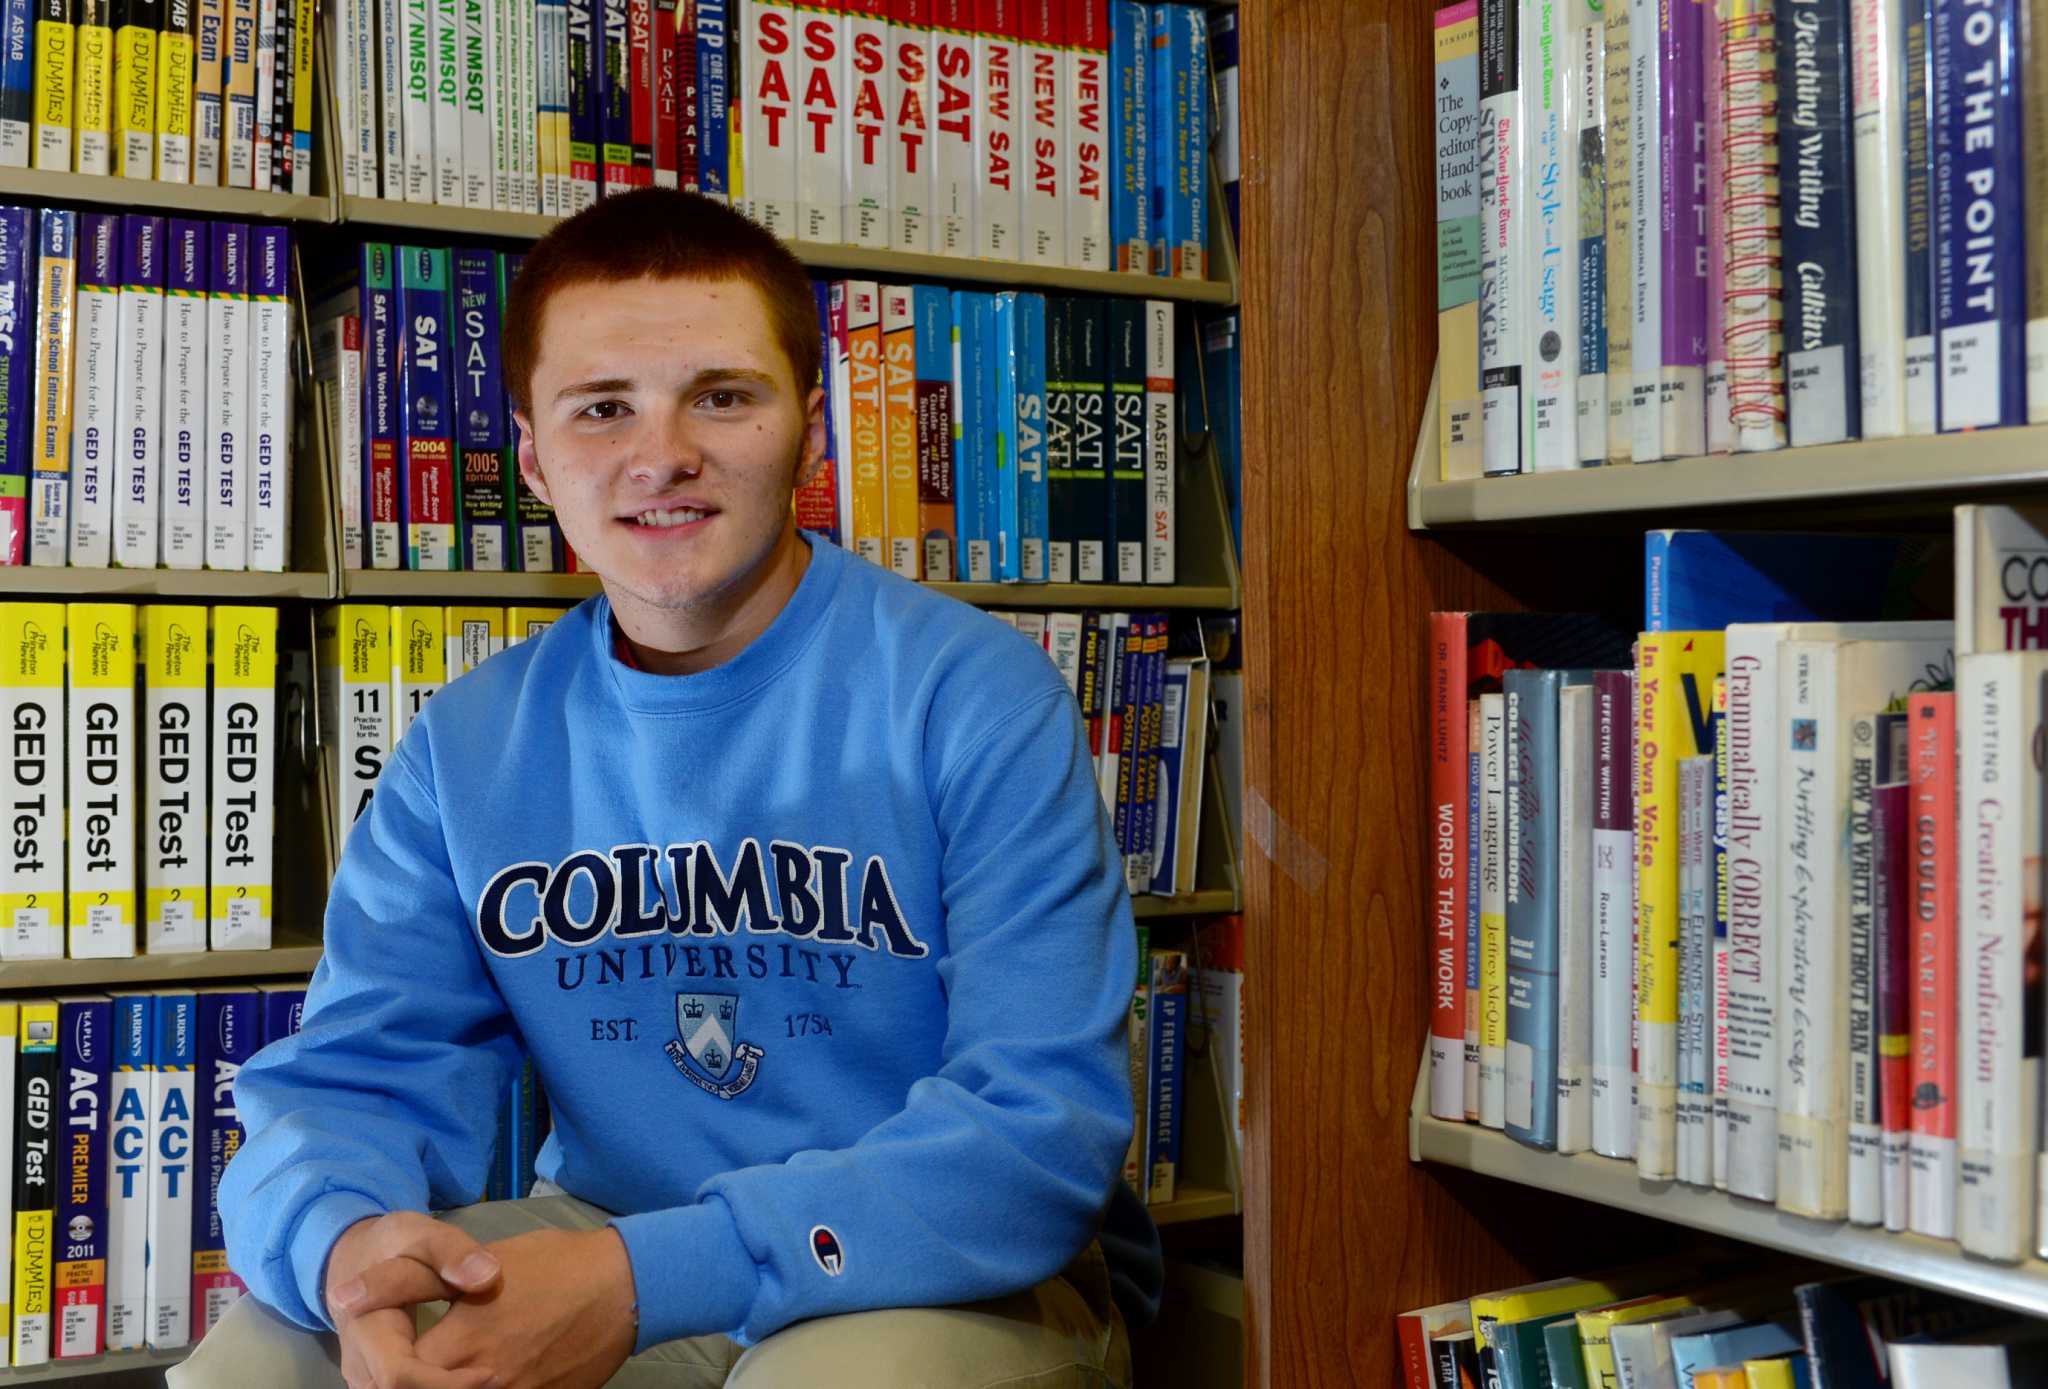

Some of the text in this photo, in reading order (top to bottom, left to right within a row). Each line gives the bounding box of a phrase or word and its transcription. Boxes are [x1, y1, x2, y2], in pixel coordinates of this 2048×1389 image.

[11, 15, 25, 61] ASVAB
[201, 15, 220, 62] Exam
[359, 34, 368, 90] Questions
[1936, 13, 1950, 125] DICTIONARY
[46, 38, 65, 123] DUMMIES
[661, 48, 674, 113] PSAT
[711, 54, 724, 118] CORE EXAMS
[758, 12, 790, 147] SAT
[804, 20, 836, 153] SAT
[938, 44, 971, 142] SAT
[988, 45, 1010, 191] NEW SAT
[1135, 54, 1145, 108] Official
[1439, 95, 1464, 113] The
[1637, 54, 1646, 112] WRITING
[1793, 10, 1824, 228] Teaching Writing
[1964, 59, 1994, 153] THE
[361, 129, 370, 153] New
[686, 87, 697, 155] PSAT
[1077, 59, 1100, 200] NEW SAT
[1136, 112, 1146, 142] SAT
[1440, 116, 1479, 134] Copy-
[1481, 108, 1495, 207] STYLE
[1135, 144, 1146, 191] Study
[1440, 159, 1480, 179] Hand-
[1441, 182, 1472, 202] book
[1497, 119, 1511, 248] The New York Times
[1536, 163, 1562, 222] Style
[1637, 143, 1646, 216] PUBLISHING
[1938, 153, 1951, 234] CONCISE
[52, 217, 63, 252] ARCO
[1137, 195, 1146, 240] Guide
[1638, 218, 1646, 279] PERSONAL
[1966, 167, 1995, 313] POINT
[462, 294, 486, 308] NEW
[1538, 246, 1562, 322] Usage
[1582, 257, 1590, 327] WRITING
[1591, 244, 1599, 372] CONVERSATION
[1638, 282, 1647, 323] ESSAYS
[1798, 262, 1826, 350] Calkins
[1940, 242, 1952, 320] WRITING
[46, 265, 63, 458] Catholic High School Entrance Exams
[373, 294, 387, 433] SAT Verbal Workbook
[415, 316, 437, 371] SAT
[465, 311, 485, 398] SAT
[84, 298, 102, 504] How to Prepare for the GED TEST
[852, 338, 879, 479] SAT 2010
[920, 397, 929, 442] Subject
[1018, 394, 1041, 483] SAT
[1076, 393, 1102, 468] SAT
[259, 434, 271, 509] GED TEST
[412, 441, 446, 452] 2004
[465, 453, 499, 472] 2005
[465, 474, 499, 482] EDITION
[932, 464, 940, 489] SAT
[938, 386, 948, 498] The Official Study
[1155, 403, 1168, 541] MASTER THE SAT
[1652, 556, 1661, 617] Practical
[353, 639, 361, 673] Review
[368, 632, 377, 648] The
[1083, 631, 1096, 712] POST OFFICE
[354, 689, 379, 713] 11
[13, 702, 46, 873] GED Test
[226, 702, 258, 867] GED Test
[1119, 704, 1134, 804] POSTAL EXAMS
[1601, 695, 1611, 820] EFFECTIVE WRITING
[1642, 646, 1659, 867] In Your Own Voice
[1731, 656, 1761, 848] Grammatically
[1483, 716, 1501, 893] Power Language
[1508, 692, 1520, 903] COLLEGE HANDBOOK
[477, 838, 928, 958] COLUMBIA
[1438, 804, 1454, 1010] WORDS THAT WORK
[1731, 858, 1761, 983] CORRECT
[1850, 758, 1872, 1055] HOW TO WRITE WITHOUT PAIN
[1977, 680, 2003, 1083] WRITING Creative Nonfiction
[556, 943, 856, 990] UNIVERSITY
[1600, 892, 1610, 978] Ross-Larson
[82, 1011, 92, 1058] KAPLAN
[132, 1003, 141, 1056] BARRON'S
[591, 1018, 638, 1041] EST.
[784, 1014, 833, 1038] 1754
[1717, 952, 1728, 1058] WRITING AND
[1158, 1000, 1176, 1144] AP FRENCH LANGUAGE
[25, 1077, 50, 1186] GED Test
[69, 1068, 98, 1204] ACT PREMIER
[113, 1088, 145, 1198] ACT
[25, 1227, 45, 1313] DUMMIES
[67, 1245, 95, 1258] 2011
[1440, 1355, 1450, 1382] LARA
